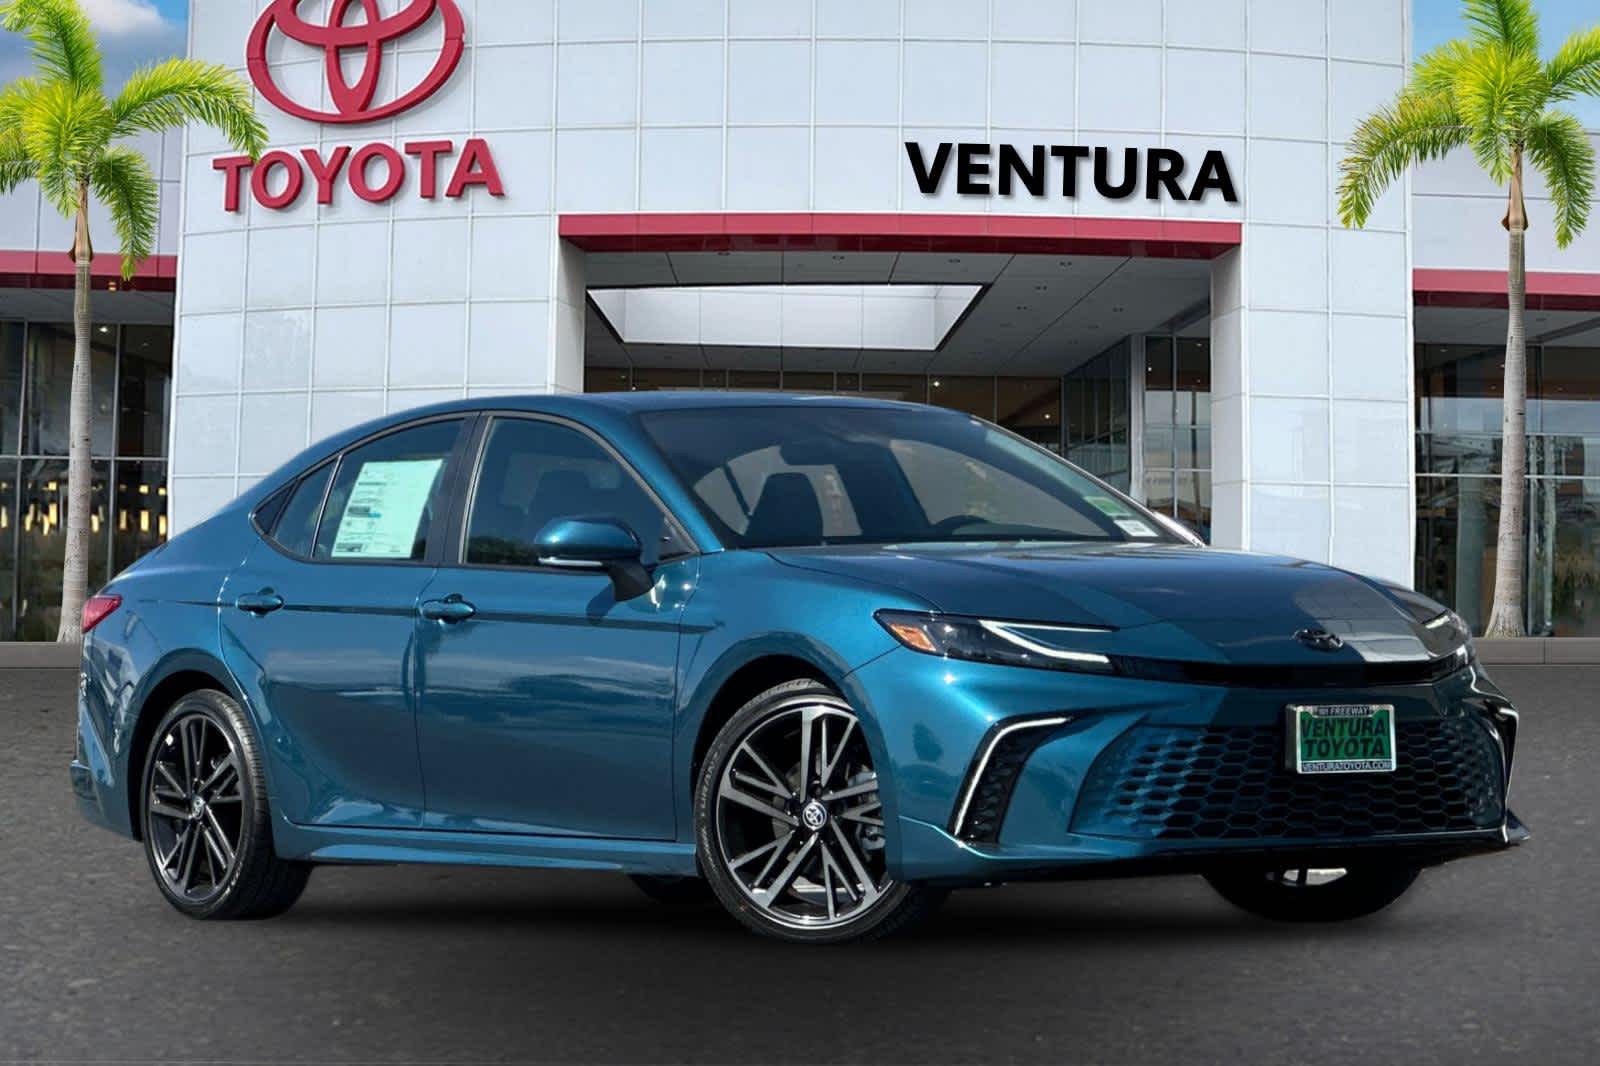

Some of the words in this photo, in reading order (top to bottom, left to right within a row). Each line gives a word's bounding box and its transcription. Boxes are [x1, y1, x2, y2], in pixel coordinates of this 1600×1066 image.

[213, 138, 505, 212] TOYOTA
[904, 141, 1239, 203] VENTURA
[1302, 718, 1387, 737] VENTURA
[1305, 738, 1385, 757] TOYOTA
